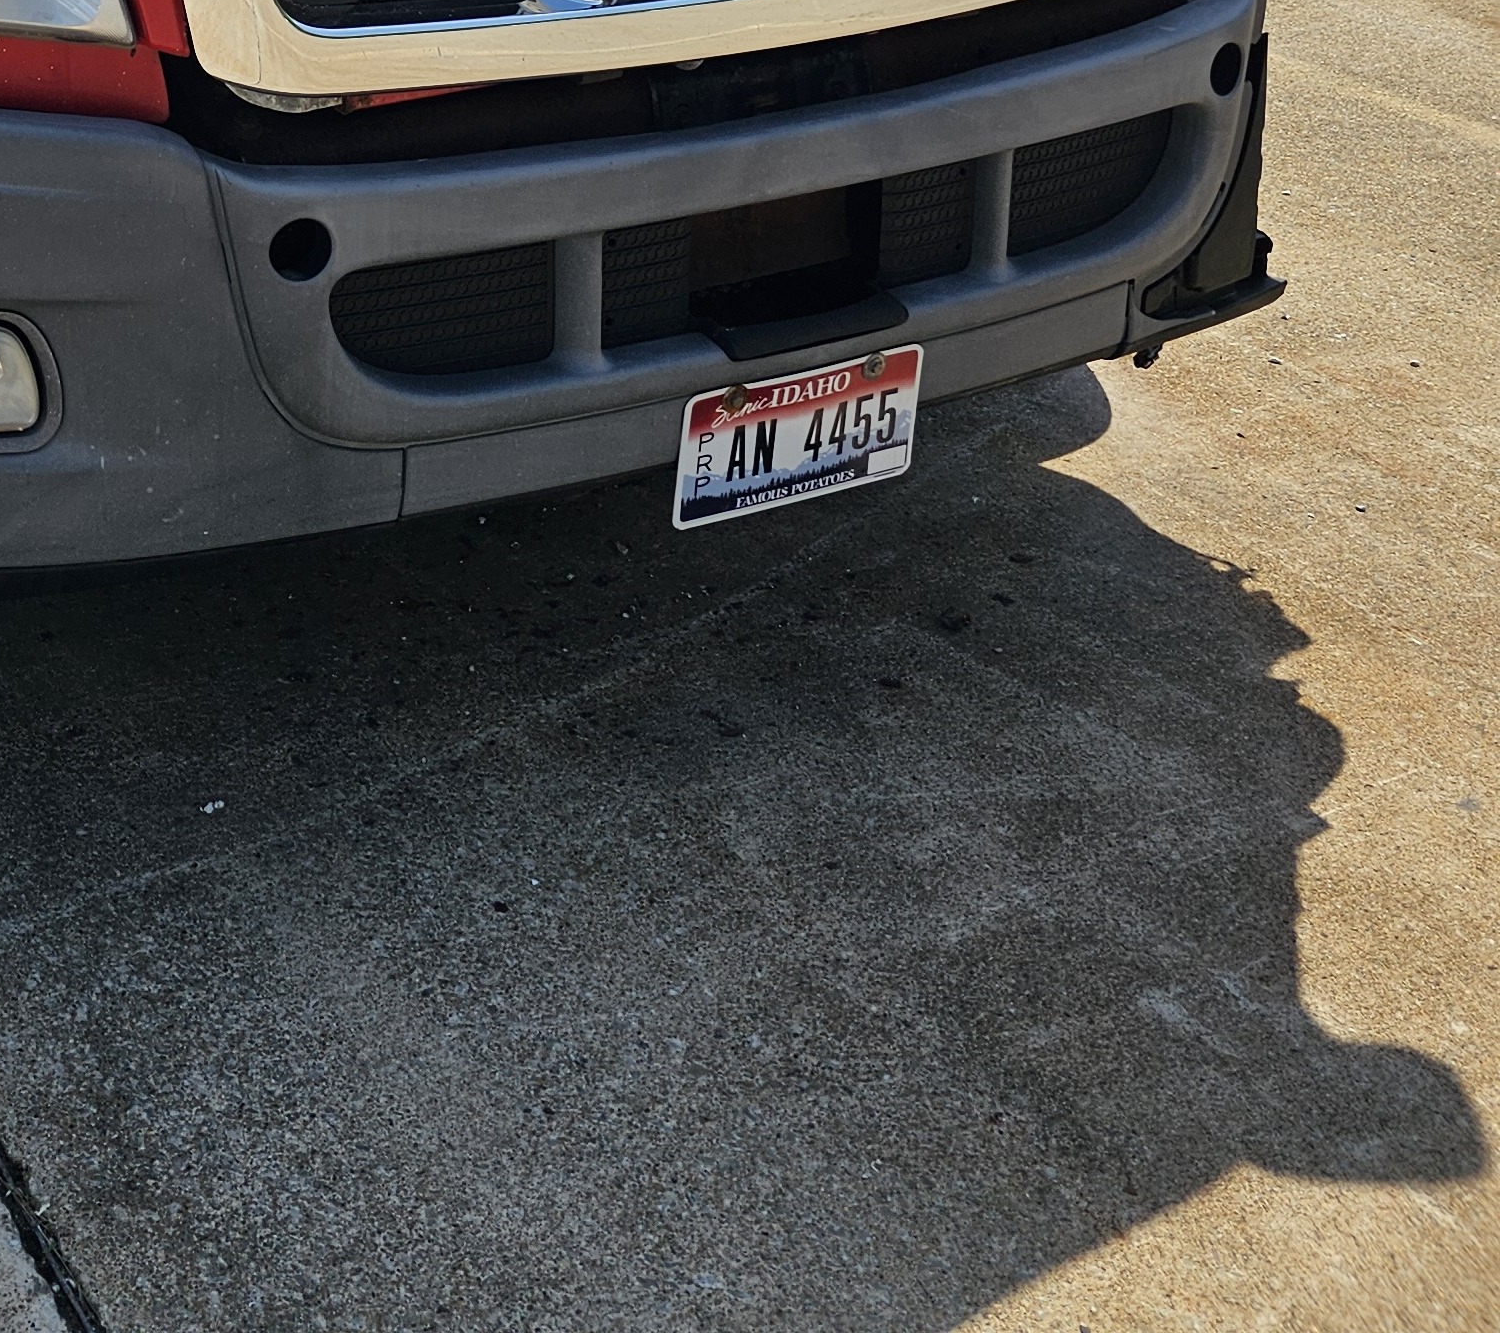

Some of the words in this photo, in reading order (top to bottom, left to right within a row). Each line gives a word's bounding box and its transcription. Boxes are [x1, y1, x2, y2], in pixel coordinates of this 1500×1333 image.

[769, 371, 851, 408] IDAHO
[725, 418, 778, 482] AN
[803, 388, 899, 463] 4455
[736, 486, 789, 508] FAMOUS
[790, 469, 855, 494] POTATOES
